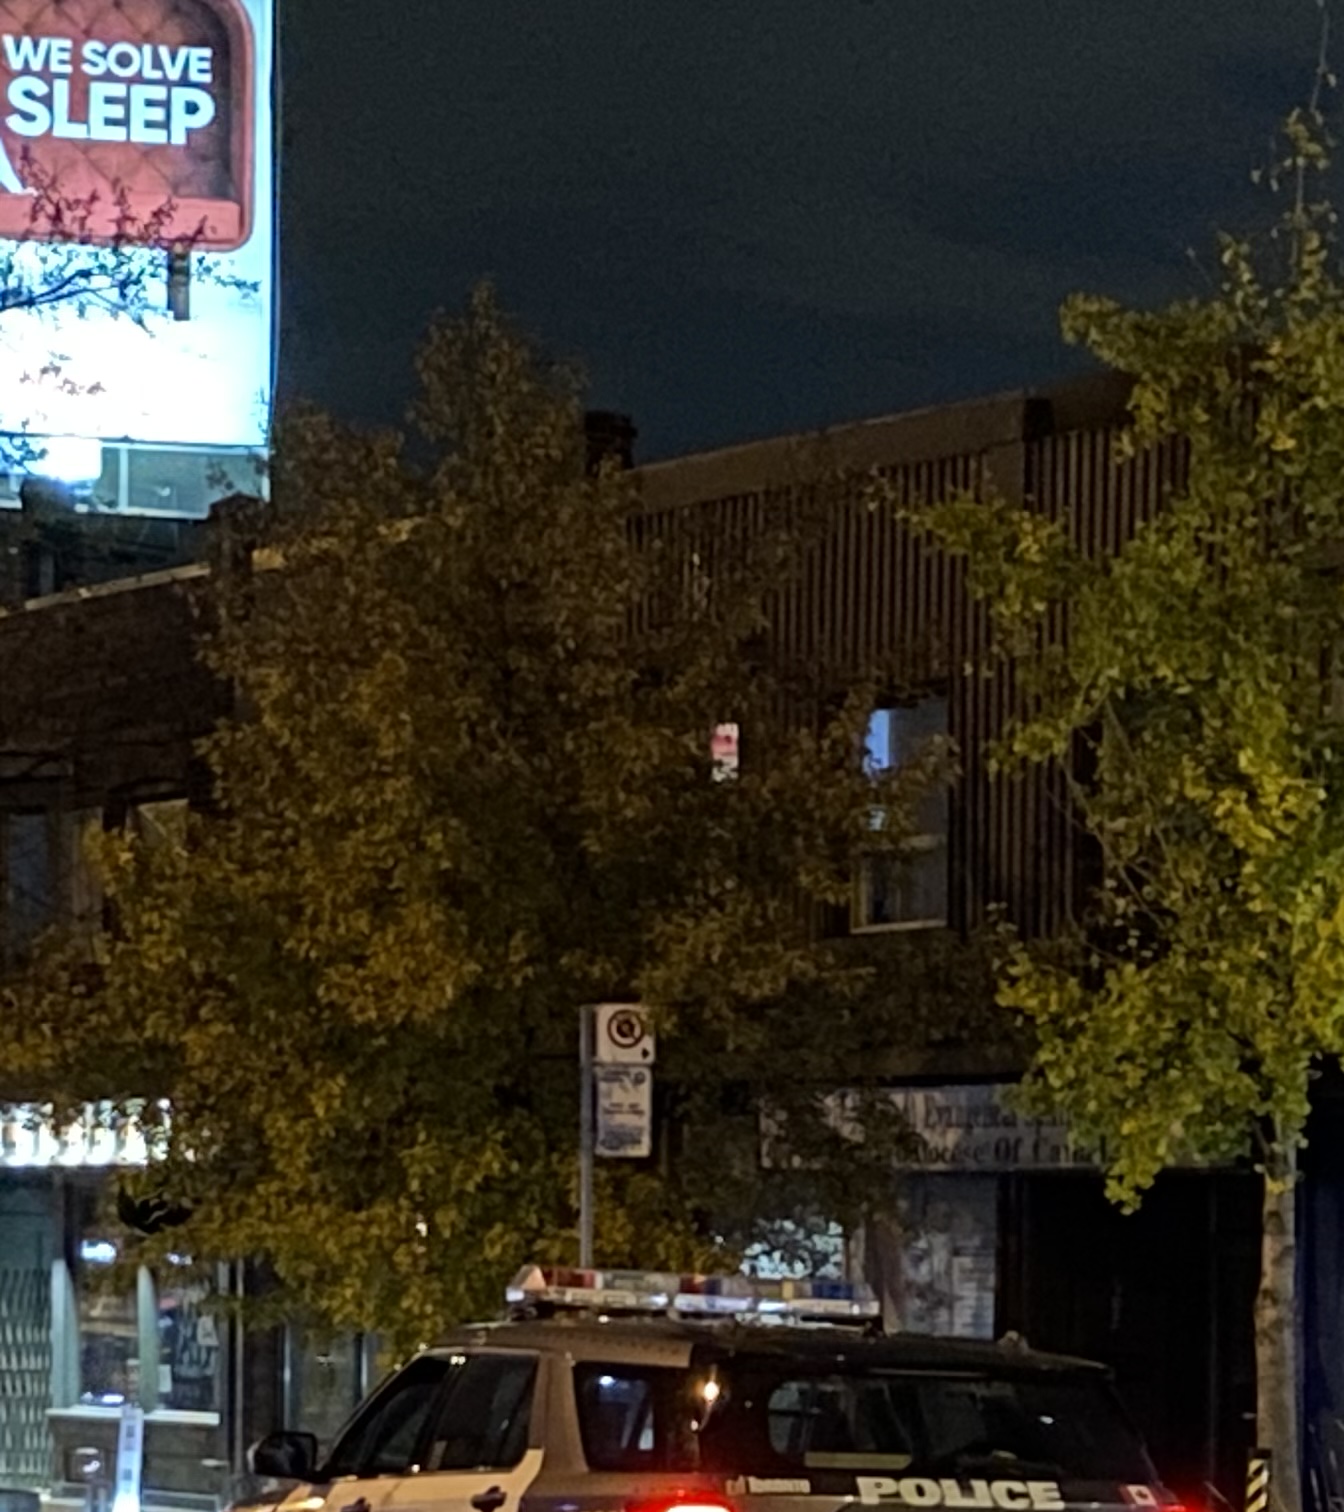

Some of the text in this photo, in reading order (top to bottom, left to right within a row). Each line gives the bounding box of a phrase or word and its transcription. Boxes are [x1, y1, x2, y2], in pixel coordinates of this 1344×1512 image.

[2, 34, 213, 84] WE SOLVE
[5, 75, 216, 145] SLEEP
[856, 1476, 1066, 1511] POLICE
